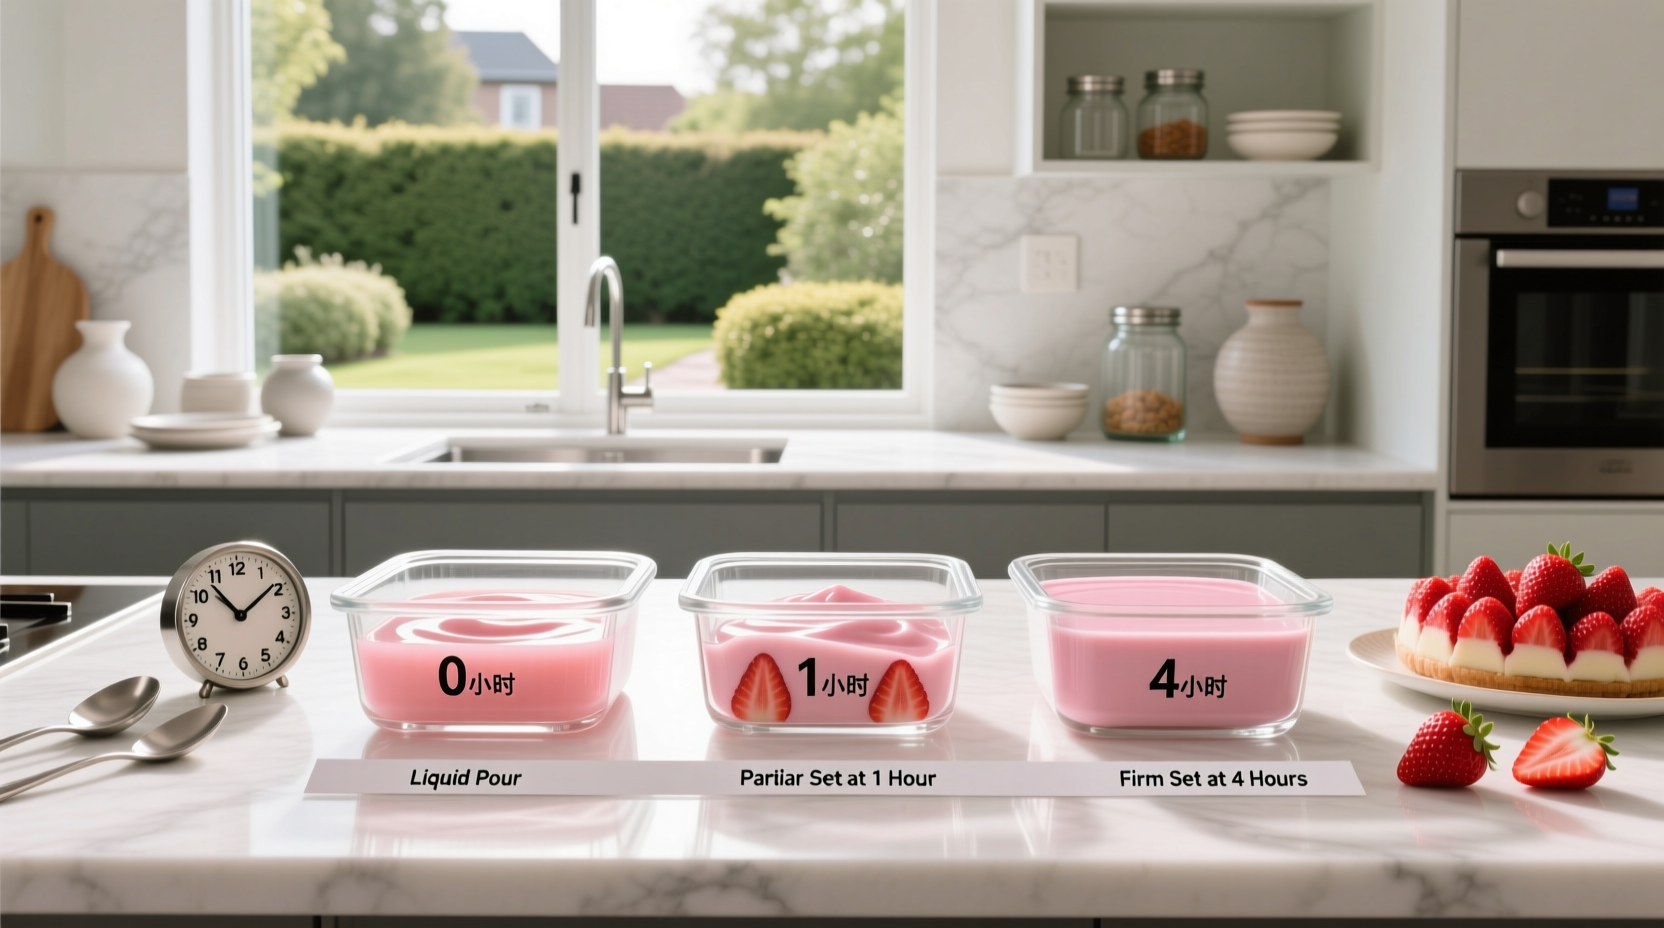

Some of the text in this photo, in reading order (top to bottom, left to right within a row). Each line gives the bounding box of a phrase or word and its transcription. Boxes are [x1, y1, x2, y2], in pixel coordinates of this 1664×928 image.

[207, 569, 222, 584] 11
[229, 561, 246, 577] 12
[257, 566, 264, 580] 1
[193, 588, 209, 604] 10
[273, 582, 284, 597] 2
[281, 605, 291, 620] 3
[188, 613, 199, 628] 9
[198, 637, 208, 651] 8
[274, 629, 285, 644] 4
[215, 652, 226, 667] 7
[260, 648, 271, 662] 5
[238, 656, 249, 671] 6
[438, 655, 516, 697] 0小时
[798, 657, 870, 698] 1小时
[1148, 658, 1228, 699] 4小时
[409, 768, 523, 791] Liquid Pour
[809, 769, 843, 787] Set
[847, 770, 867, 787] at
[872, 769, 881, 786] 1
[888, 769, 937, 787] Hour
[1119, 769, 1308, 787] Firm Set at 4 Hours
